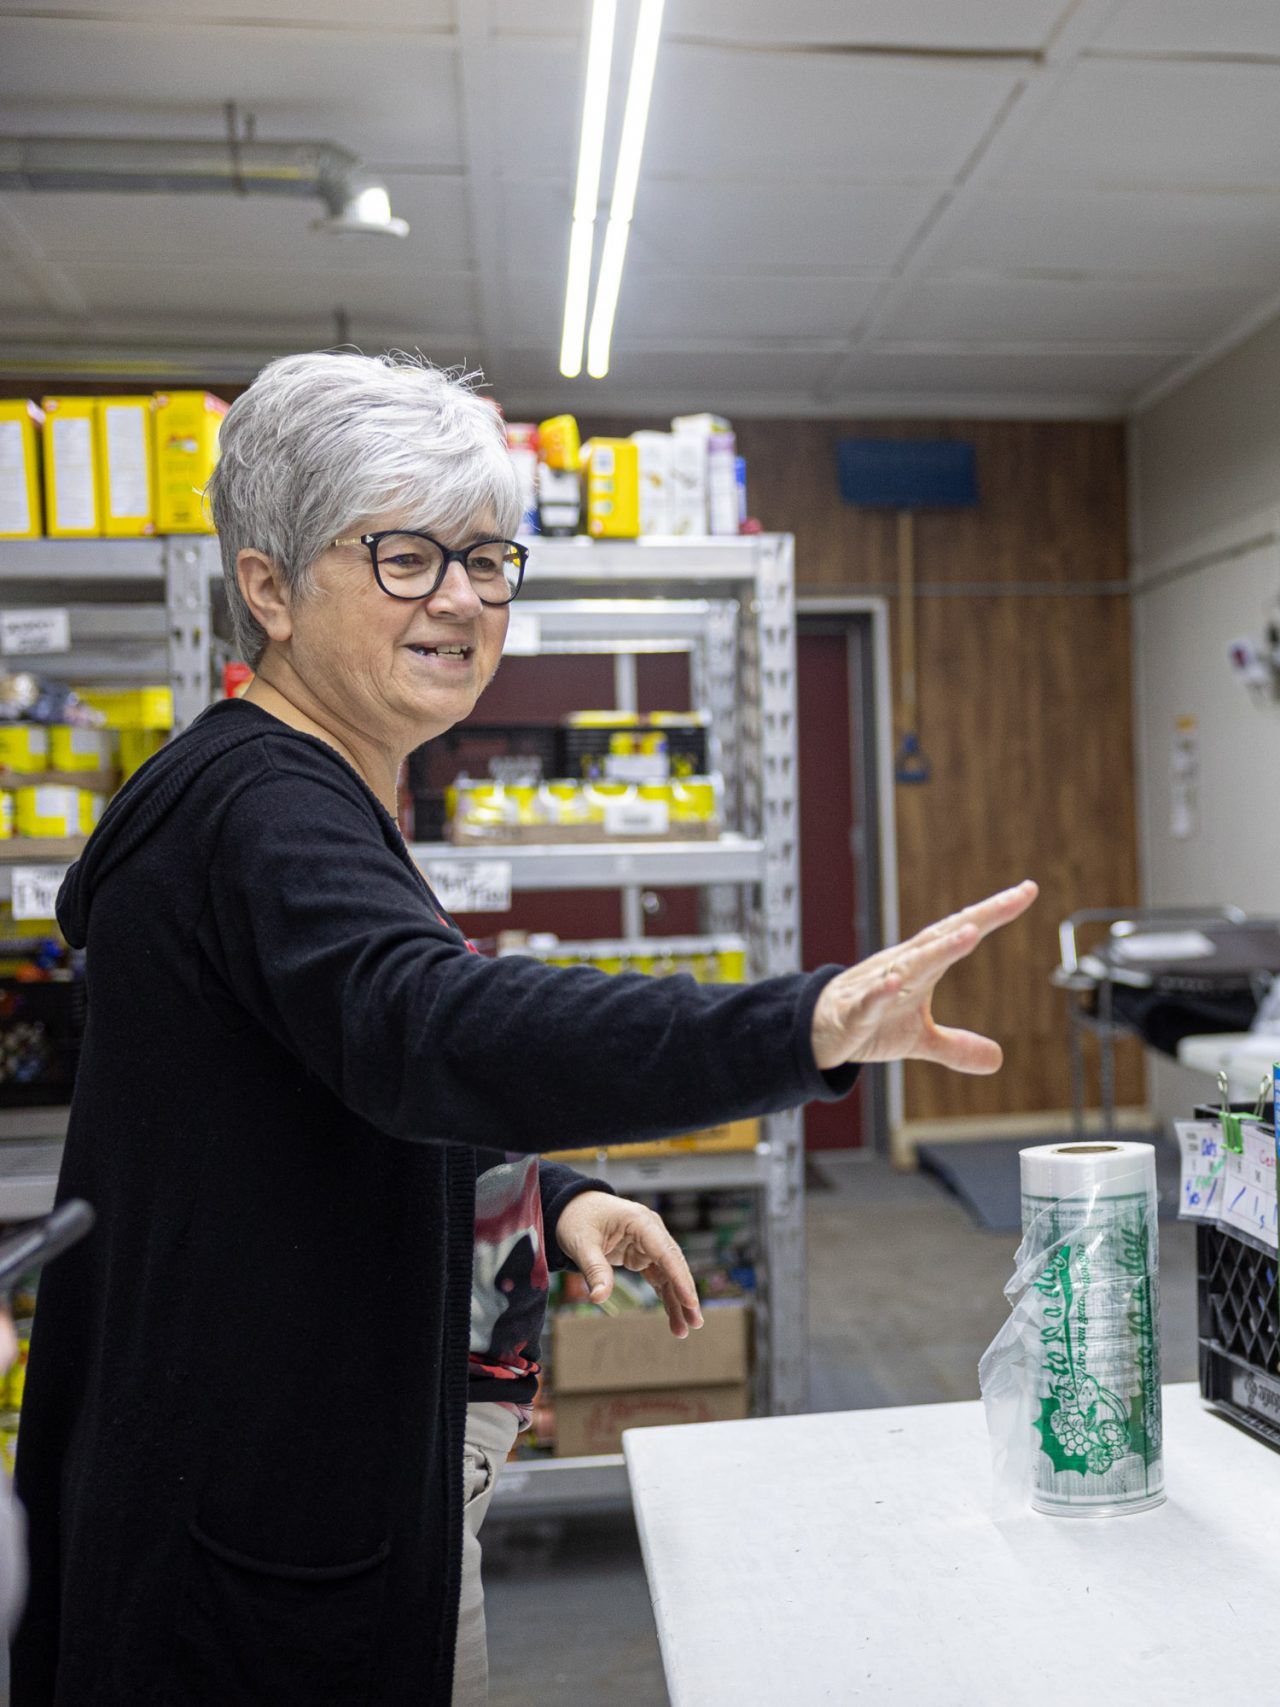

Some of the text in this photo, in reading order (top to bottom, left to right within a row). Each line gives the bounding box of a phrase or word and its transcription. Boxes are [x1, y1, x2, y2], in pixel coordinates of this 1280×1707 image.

[1043, 1306, 1063, 1318] a
[1077, 1326, 1089, 1351] you
[1041, 1351, 1070, 1376] to
